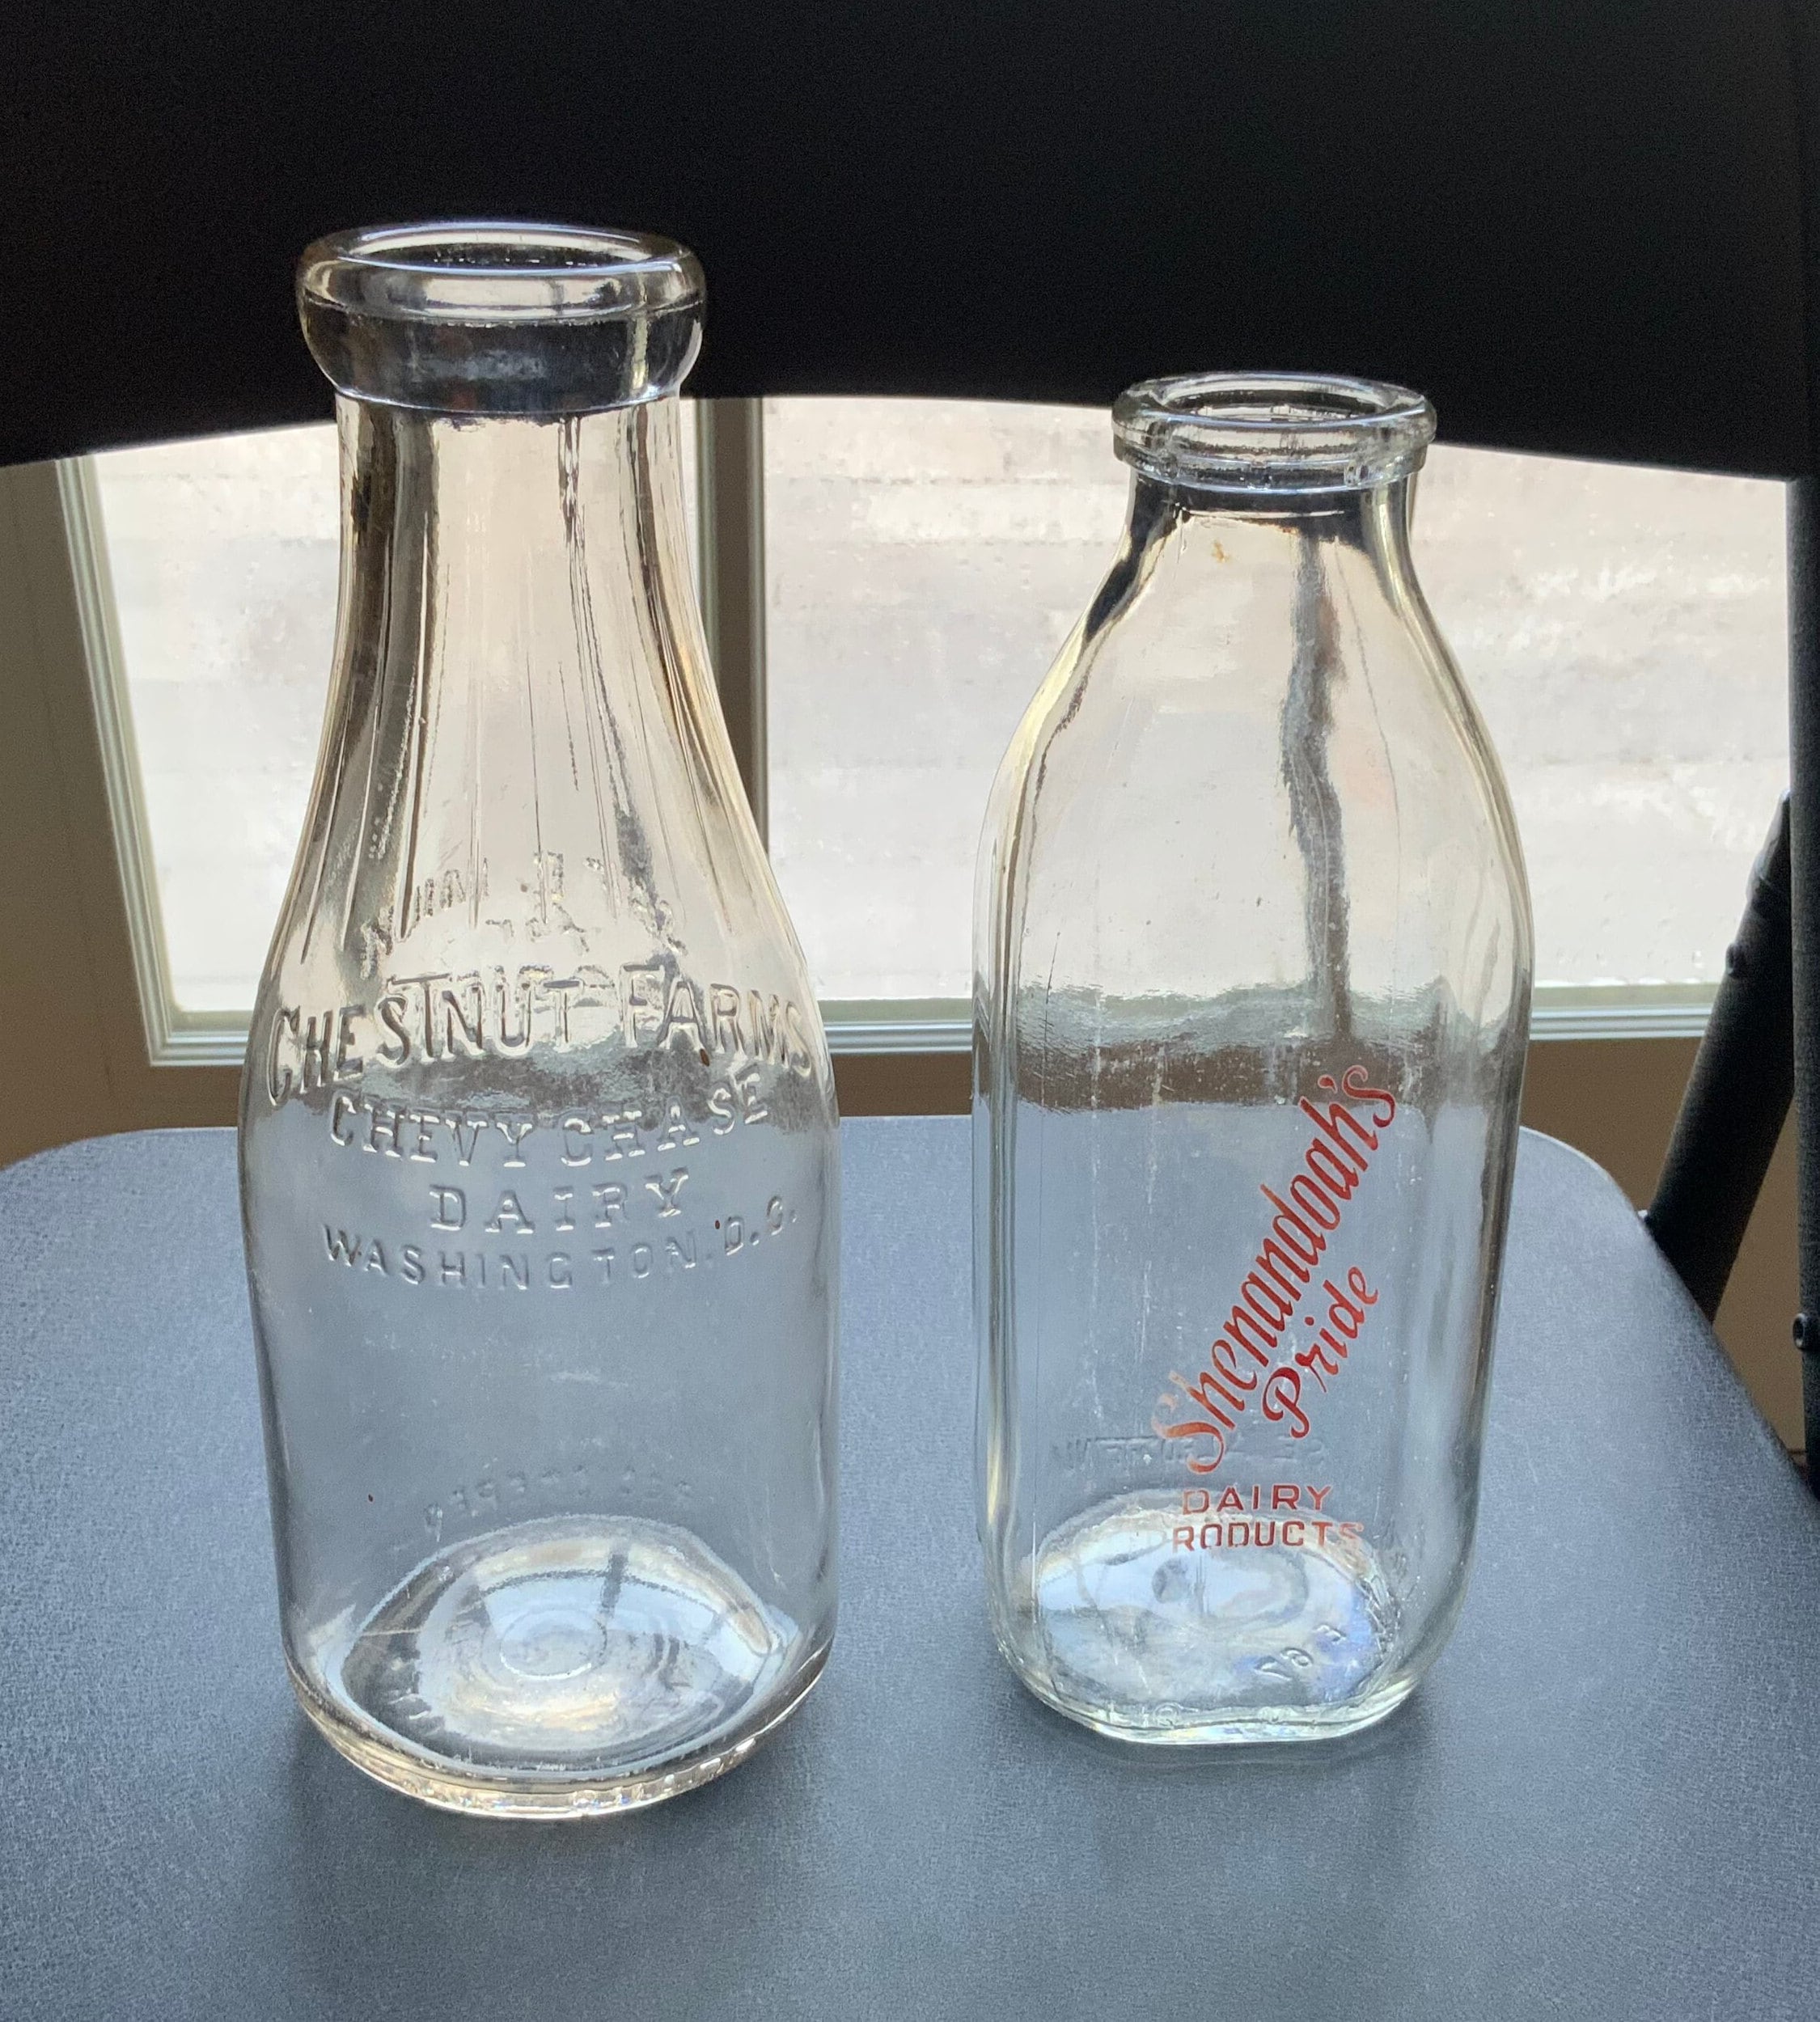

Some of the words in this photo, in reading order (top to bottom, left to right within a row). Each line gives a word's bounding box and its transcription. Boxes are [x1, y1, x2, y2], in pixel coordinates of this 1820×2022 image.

[269, 972, 581, 1106] CHESTNUT
[619, 964, 811, 1079] FARMS
[330, 1089, 534, 1168] CHEVY
[560, 1062, 768, 1167] CHASE
[429, 1167, 689, 1235] DAIRY
[1151, 1064, 1396, 1474] Shenandoah's
[1262, 1265, 1379, 1439] Pride
[1170, 1519, 1365, 1553] RODUCTS
[1182, 1483, 1334, 1516] DAIRY
